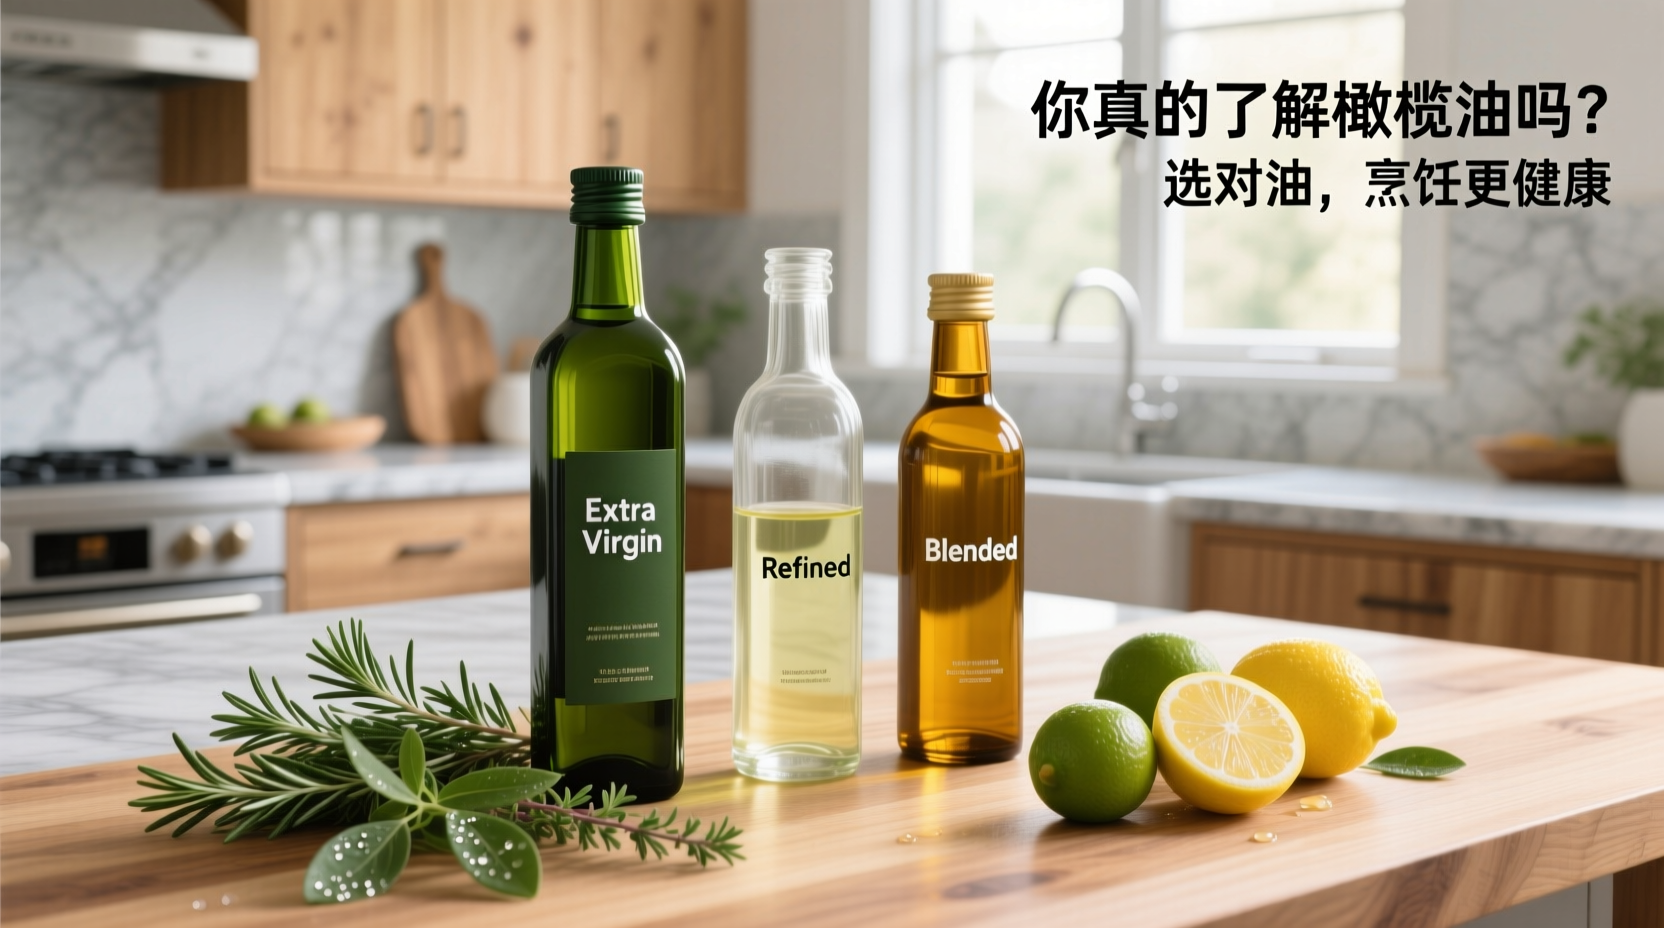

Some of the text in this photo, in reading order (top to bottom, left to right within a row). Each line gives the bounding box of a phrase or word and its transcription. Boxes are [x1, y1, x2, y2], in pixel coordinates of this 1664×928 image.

[586, 498, 656, 522] Extra
[582, 528, 662, 561] Virgin
[925, 535, 1017, 562] Blended
[762, 553, 851, 579] Refined
